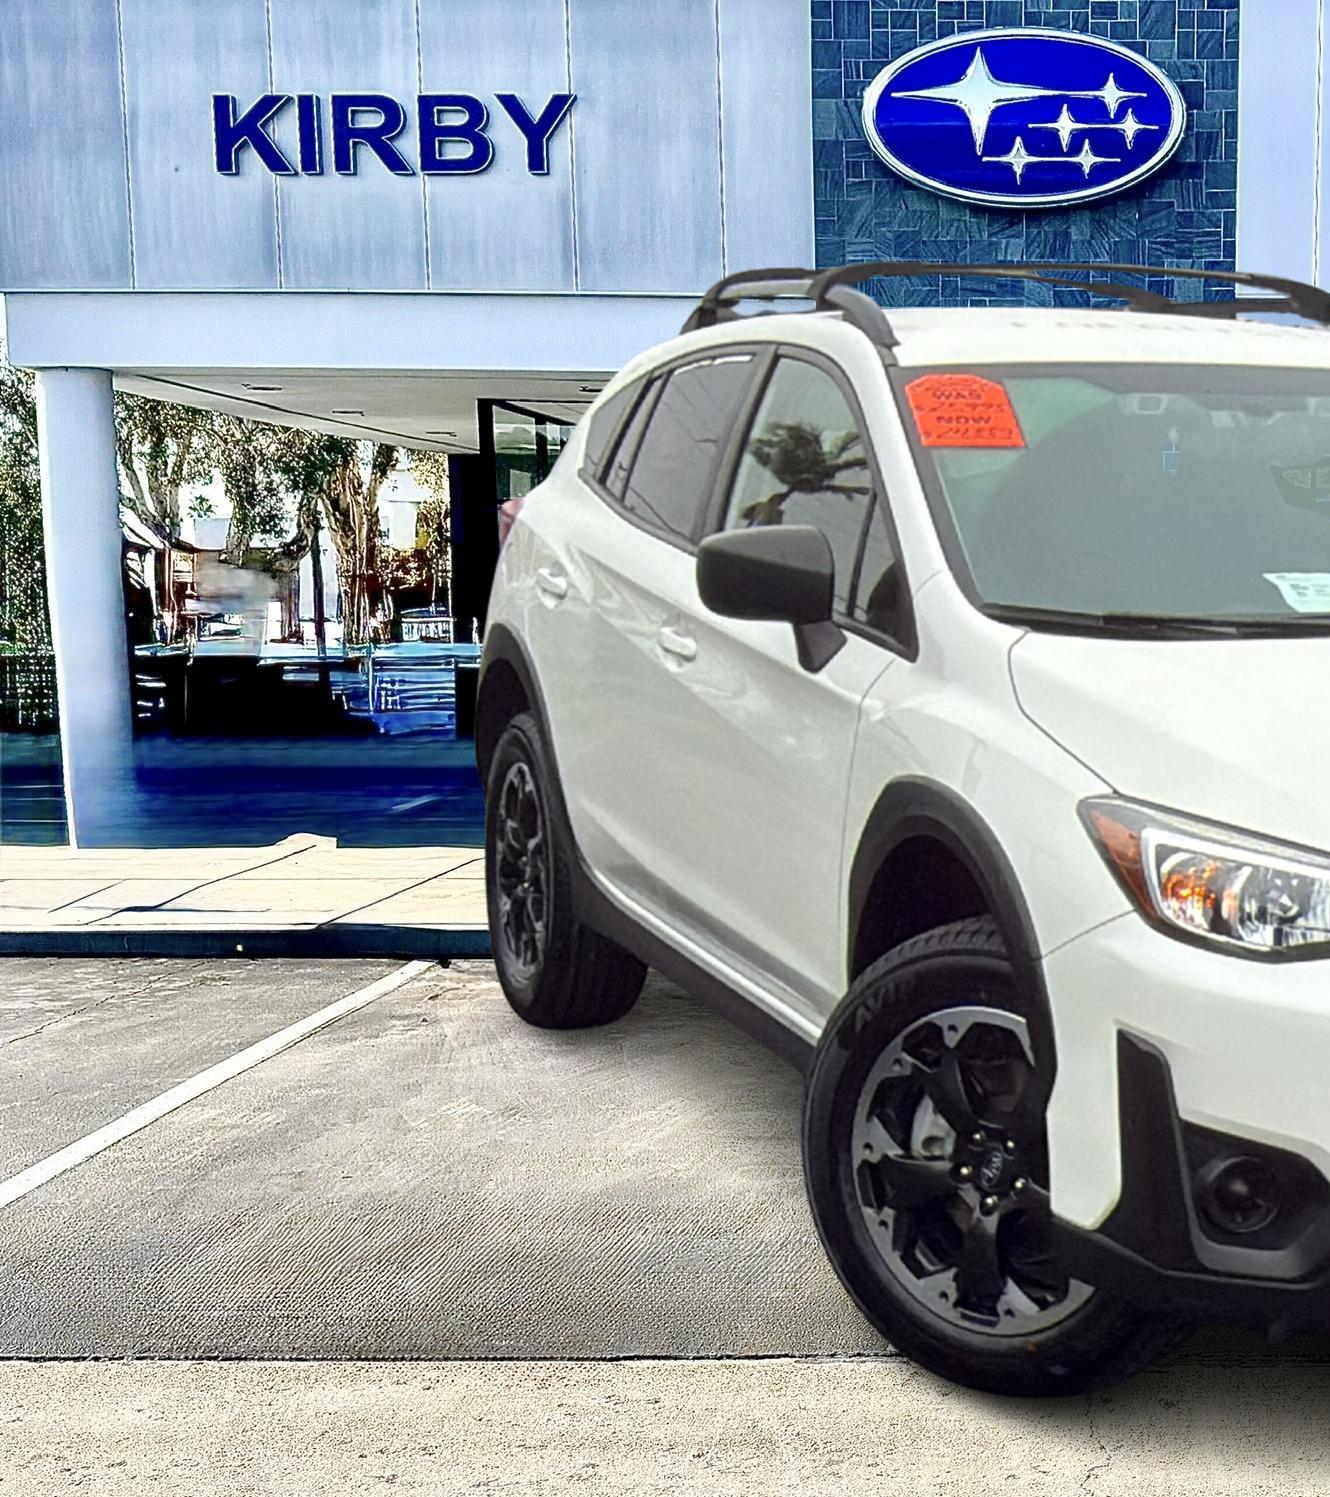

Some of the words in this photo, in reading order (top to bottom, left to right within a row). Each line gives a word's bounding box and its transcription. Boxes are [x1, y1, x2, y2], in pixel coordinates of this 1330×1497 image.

[211, 93, 577, 176] KIRBY
[931, 390, 983, 401] WAS
[935, 414, 992, 425] NOW
